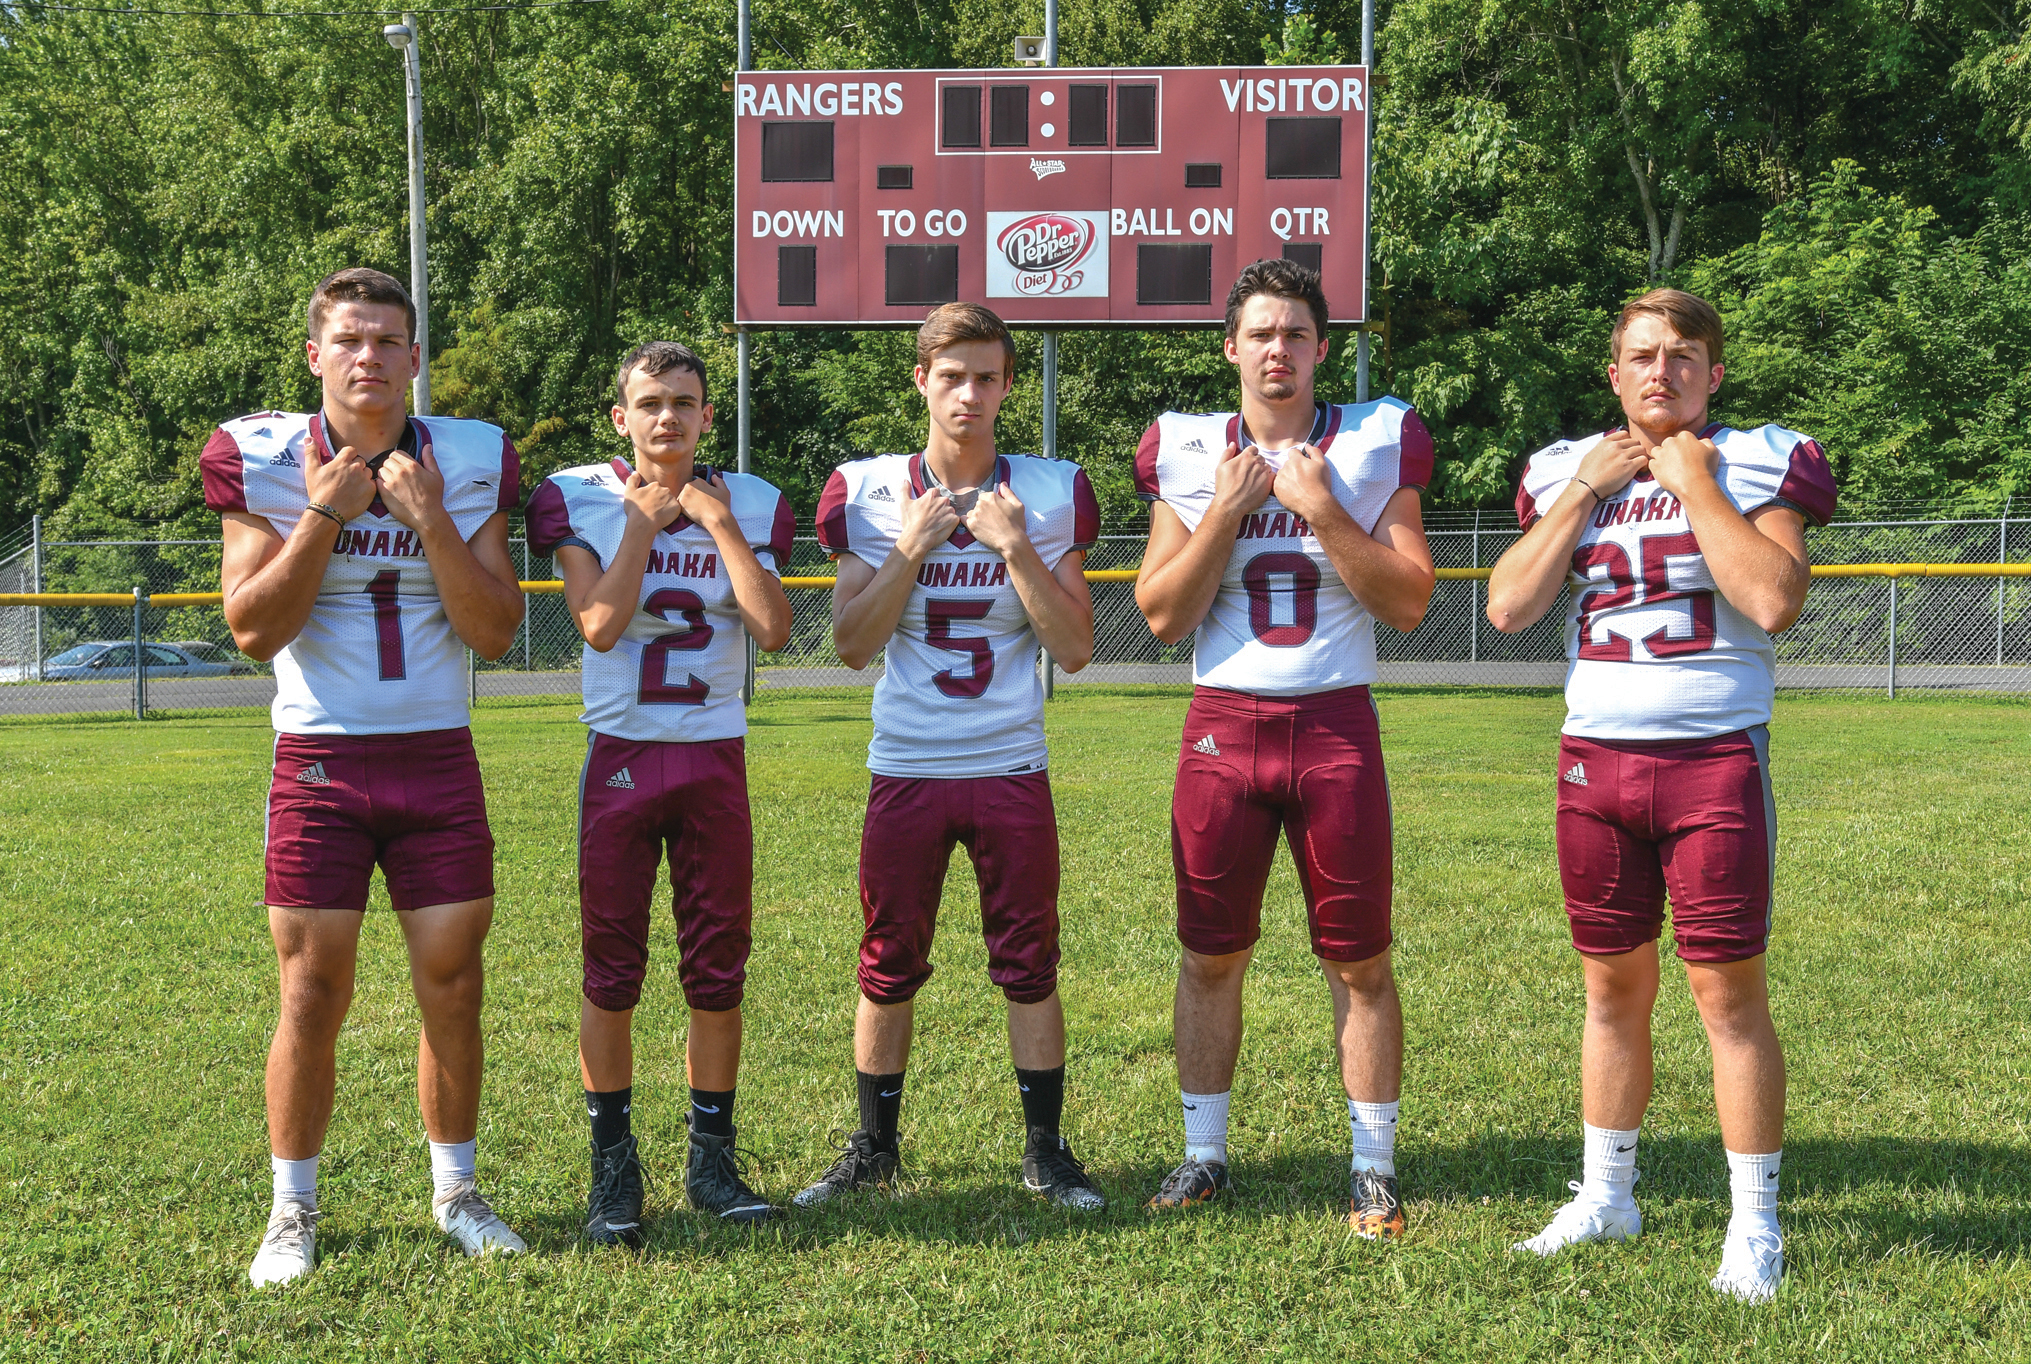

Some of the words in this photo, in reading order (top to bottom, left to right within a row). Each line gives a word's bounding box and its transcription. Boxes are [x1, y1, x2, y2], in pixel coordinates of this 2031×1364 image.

[738, 82, 903, 116] RANGERS
[1219, 78, 1364, 112] VISITOR
[752, 210, 844, 237] DOWN
[877, 209, 916, 237] TO
[924, 209, 967, 237] GO
[1035, 222, 1062, 245] Dr
[1111, 208, 1181, 236] BALL
[1189, 207, 1233, 236] ON
[1270, 207, 1330, 240] QTR
[1017, 228, 1080, 265] Pepper
[1023, 273, 1047, 289] Diet
[269, 457, 301, 468] adidas
[867, 493, 896, 503] adidas
[1594, 496, 1682, 528] UNAKA
[1236, 512, 1316, 539] NAK
[645, 549, 717, 578] NAKA
[917, 562, 1006, 588] UNAKA
[1241, 550, 1322, 648] 0
[1571, 531, 1718, 662] 25
[363, 569, 407, 681] 1
[637, 587, 714, 706] 2
[925, 597, 996, 699] 5
[1193, 744, 1220, 756] adidas
[297, 773, 331, 785] adidas
[606, 779, 635, 790] adidas
[1563, 773, 1588, 786] adidas
